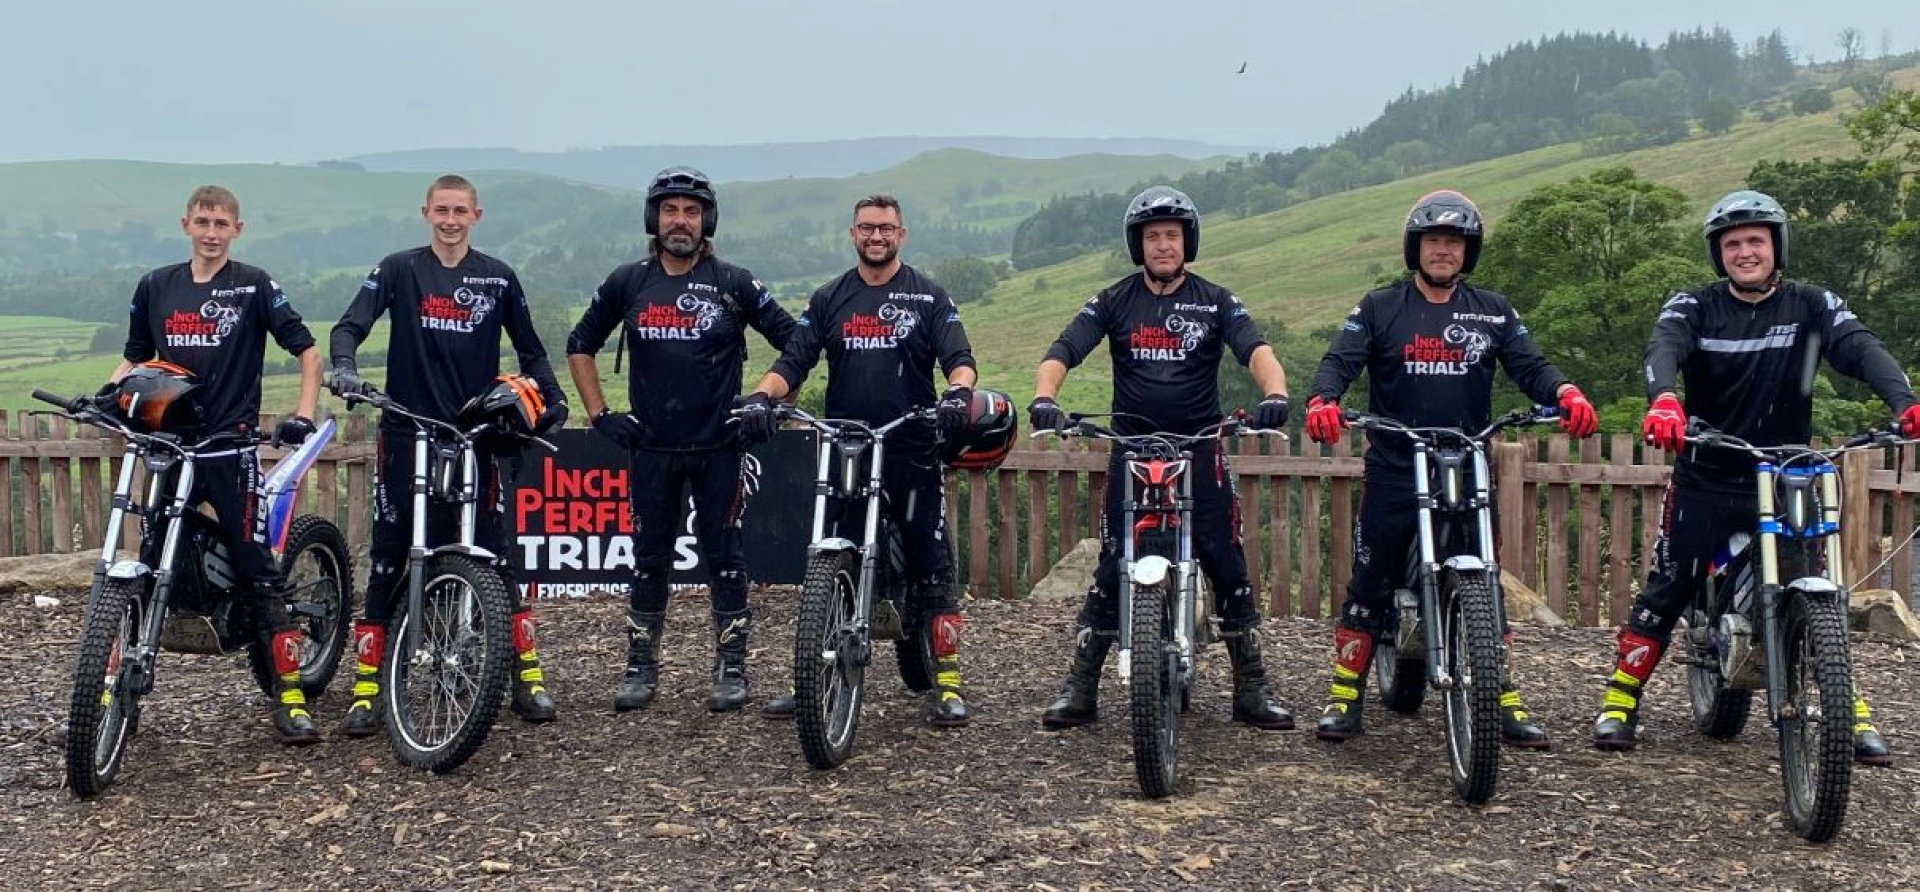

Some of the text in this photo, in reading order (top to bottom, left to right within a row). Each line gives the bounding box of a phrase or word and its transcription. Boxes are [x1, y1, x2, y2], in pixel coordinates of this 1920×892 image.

[648, 302, 677, 315] INCH
[174, 310, 200, 323] INCH
[638, 312, 696, 328] PERFECT
[852, 312, 879, 326] INCH
[165, 320, 216, 334] PERFECT
[420, 316, 474, 333] TRIALS
[843, 322, 893, 337] PERFECT
[638, 327, 700, 340] TRIALS
[1131, 333, 1183, 348] PERFECT
[166, 335, 221, 347] TRIALS
[843, 336, 899, 350] TRIALS
[1414, 334, 1445, 348] INCH
[1131, 348, 1187, 361] TRIALS
[1403, 345, 1465, 362] PERFECT
[1404, 361, 1469, 376] TRIALS
[543, 457, 628, 498] INCH
[516, 488, 634, 534] PERFE
[517, 536, 699, 571] TRIAS
